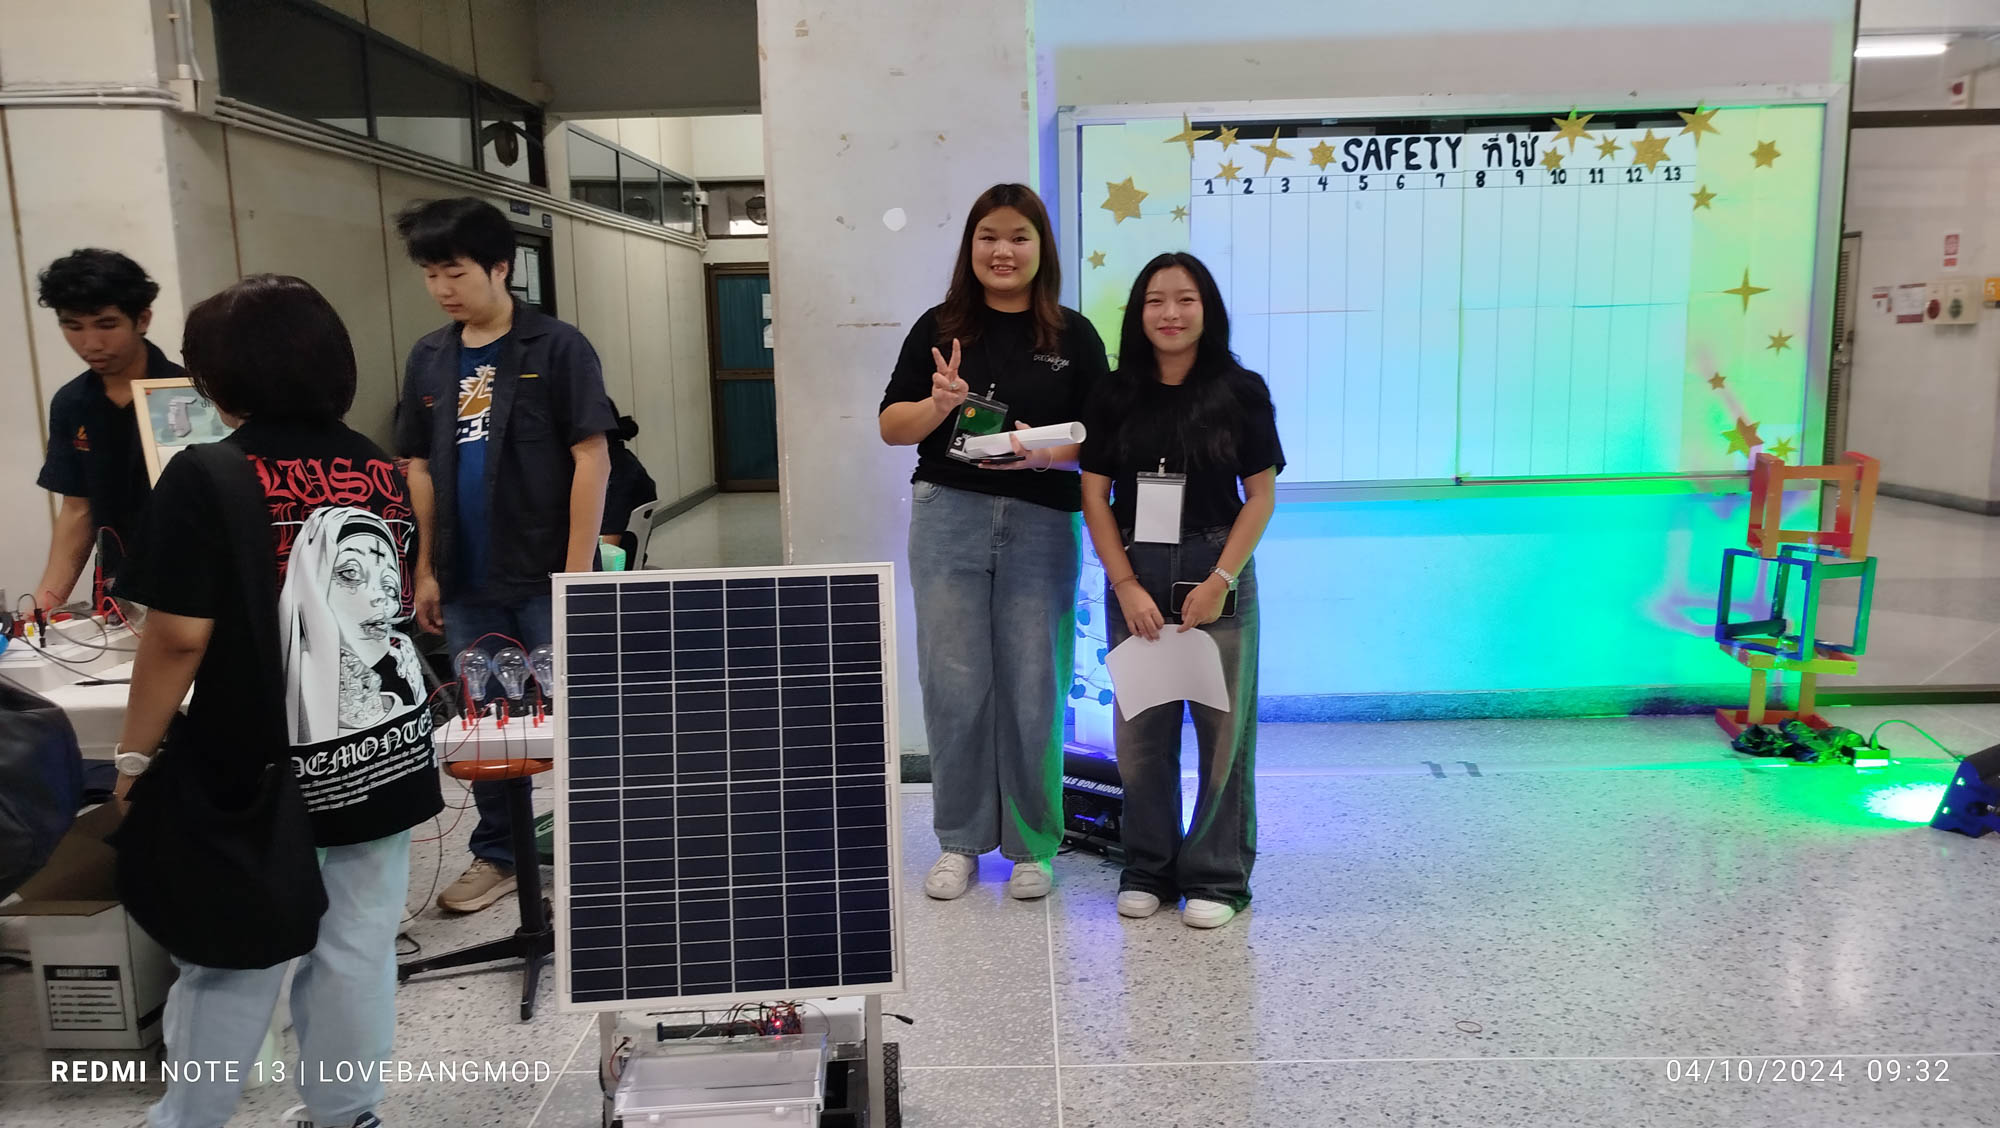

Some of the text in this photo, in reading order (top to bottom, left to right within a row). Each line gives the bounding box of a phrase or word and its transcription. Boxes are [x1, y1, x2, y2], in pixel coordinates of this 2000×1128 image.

[1341, 136, 1462, 173] SAFETY
[1204, 166, 1681, 194] 1 2 3 4 5 6 7 8 9 10 11 12 13
